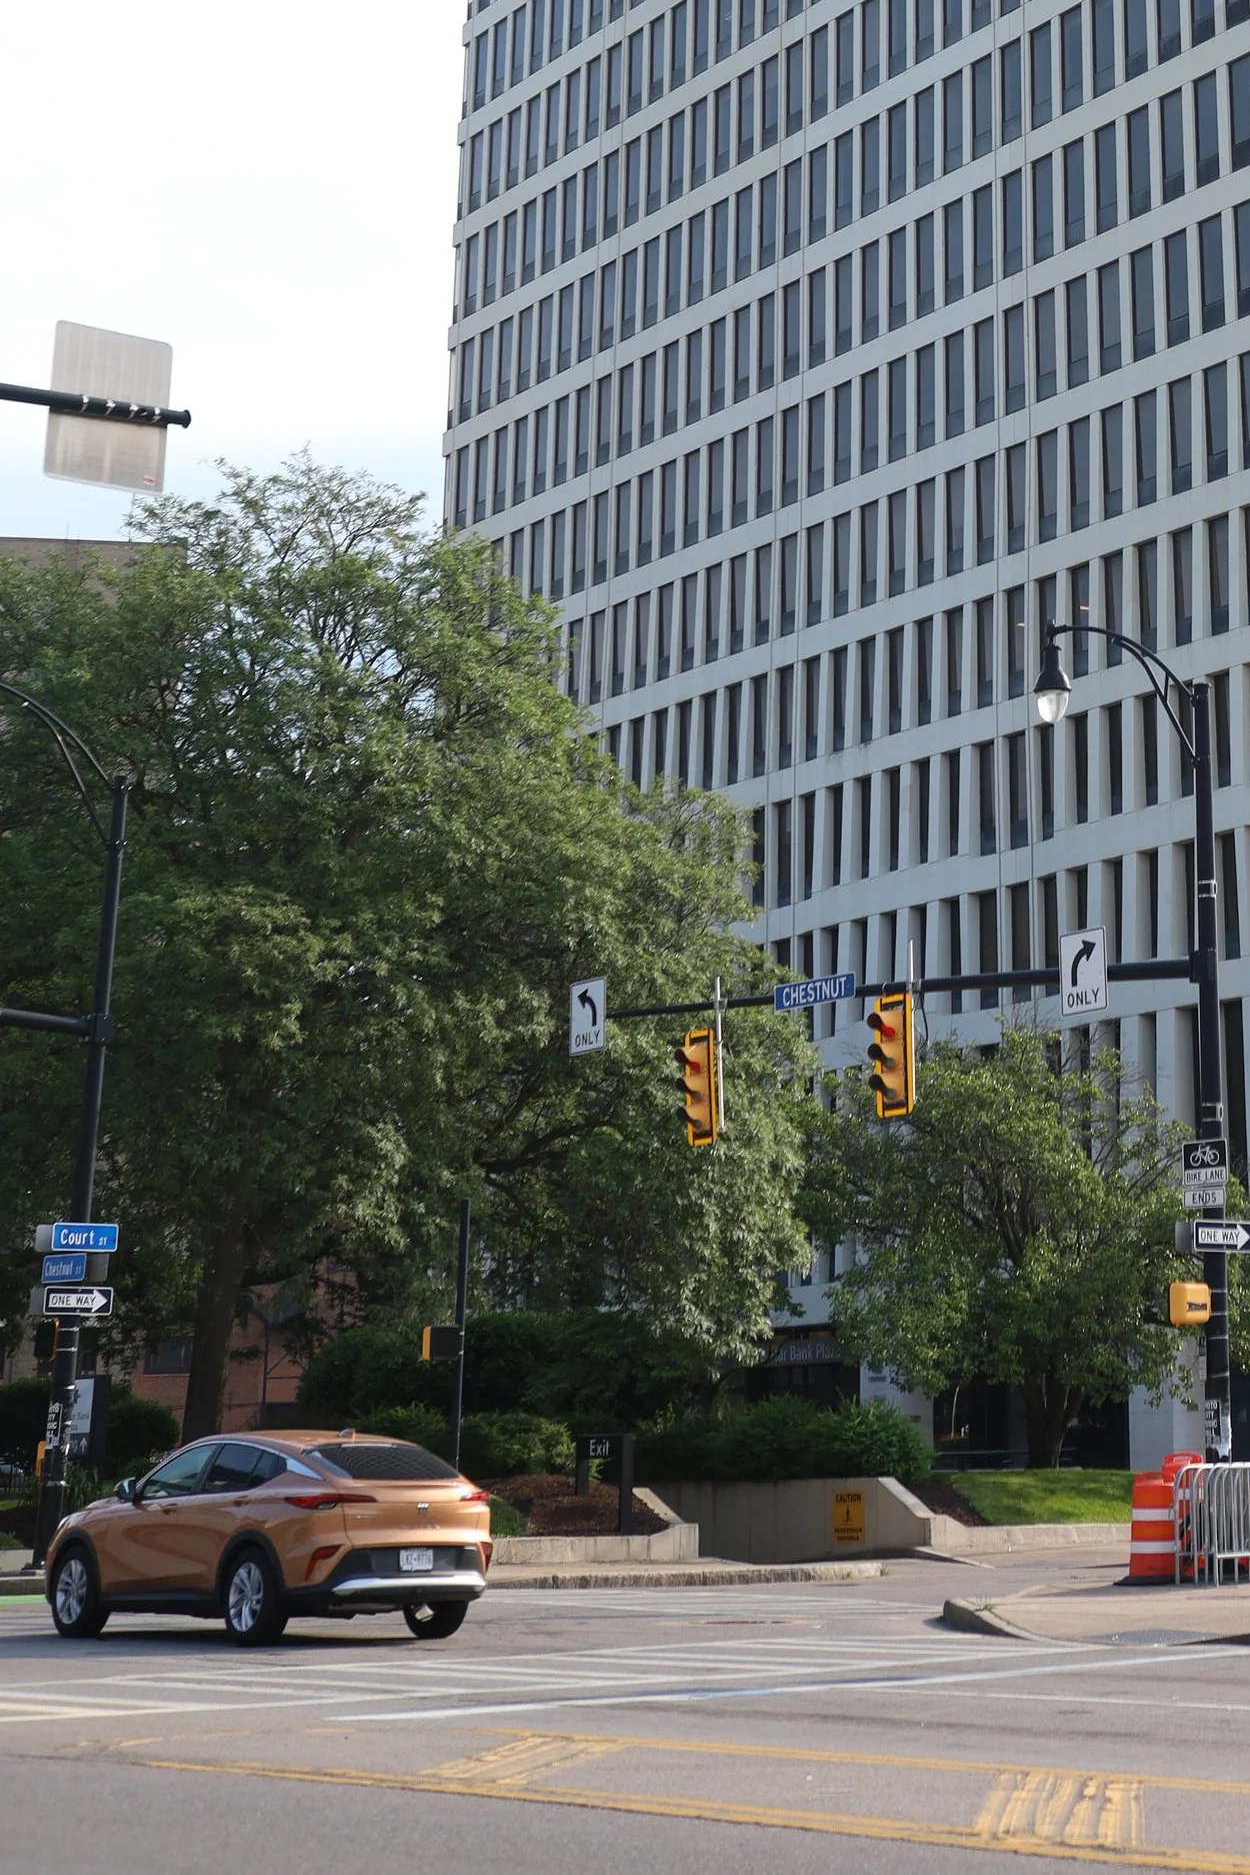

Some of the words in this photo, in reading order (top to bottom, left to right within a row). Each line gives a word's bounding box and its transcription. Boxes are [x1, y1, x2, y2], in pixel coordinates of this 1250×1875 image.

[782, 976, 847, 1007] CHESTNUT
[1067, 987, 1100, 1008] ONLY
[574, 1028, 601, 1048] ONLY
[1186, 1172, 1202, 1183] BIKE
[1205, 1170, 1225, 1181] LANE
[1192, 1192, 1217, 1204] ENDS
[60, 1228, 95, 1245] Court
[1200, 1230, 1218, 1242] ONE
[1221, 1230, 1240, 1242] WAY
[44, 1260, 74, 1278] Chestnut
[51, 1294, 72, 1306] ONE
[76, 1295, 97, 1307] WAY
[789, 1344, 814, 1361] Bank
[589, 1438, 610, 1457] Exit
[835, 1492, 862, 1503] CAUTION
